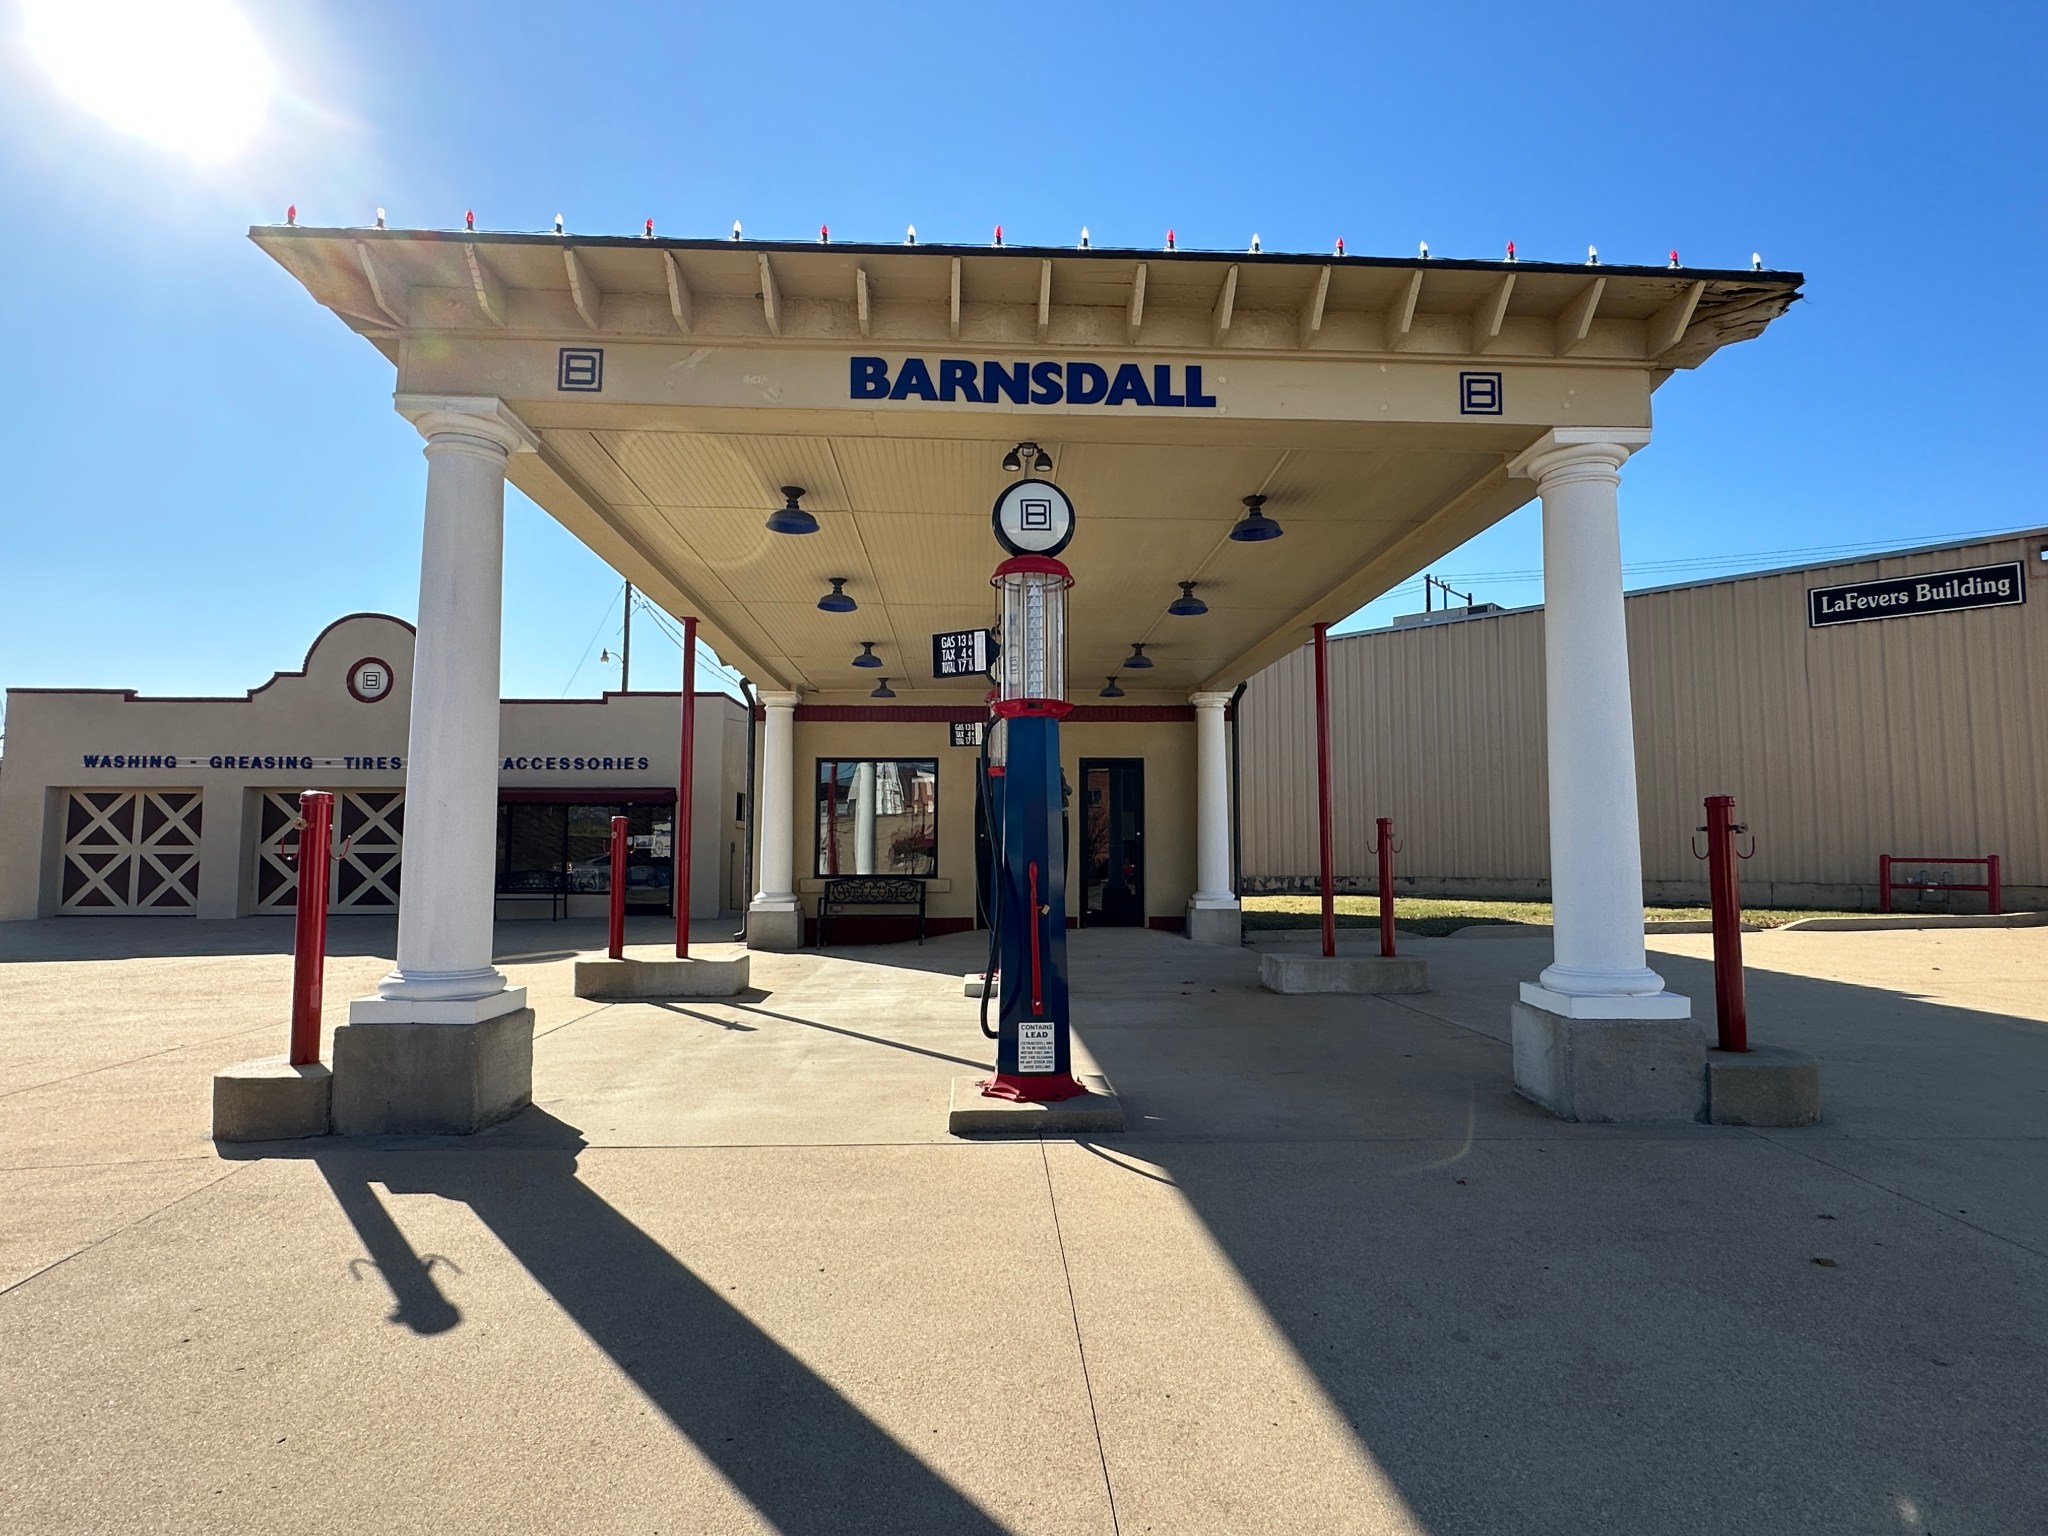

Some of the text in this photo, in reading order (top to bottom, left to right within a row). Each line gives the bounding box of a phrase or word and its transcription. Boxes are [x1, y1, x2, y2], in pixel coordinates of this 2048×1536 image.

[850, 356, 1217, 408] BARNSDALL
[1821, 577, 2011, 614] LaFevers Building
[941, 635, 956, 648] GAS
[941, 649, 956, 661] TAX
[941, 661, 956, 674] TOTAL
[83, 754, 177, 768] WASHING
[209, 755, 313, 769] GREASING
[343, 756, 402, 770] TIRES
[502, 756, 649, 770] ACCESSORIES
